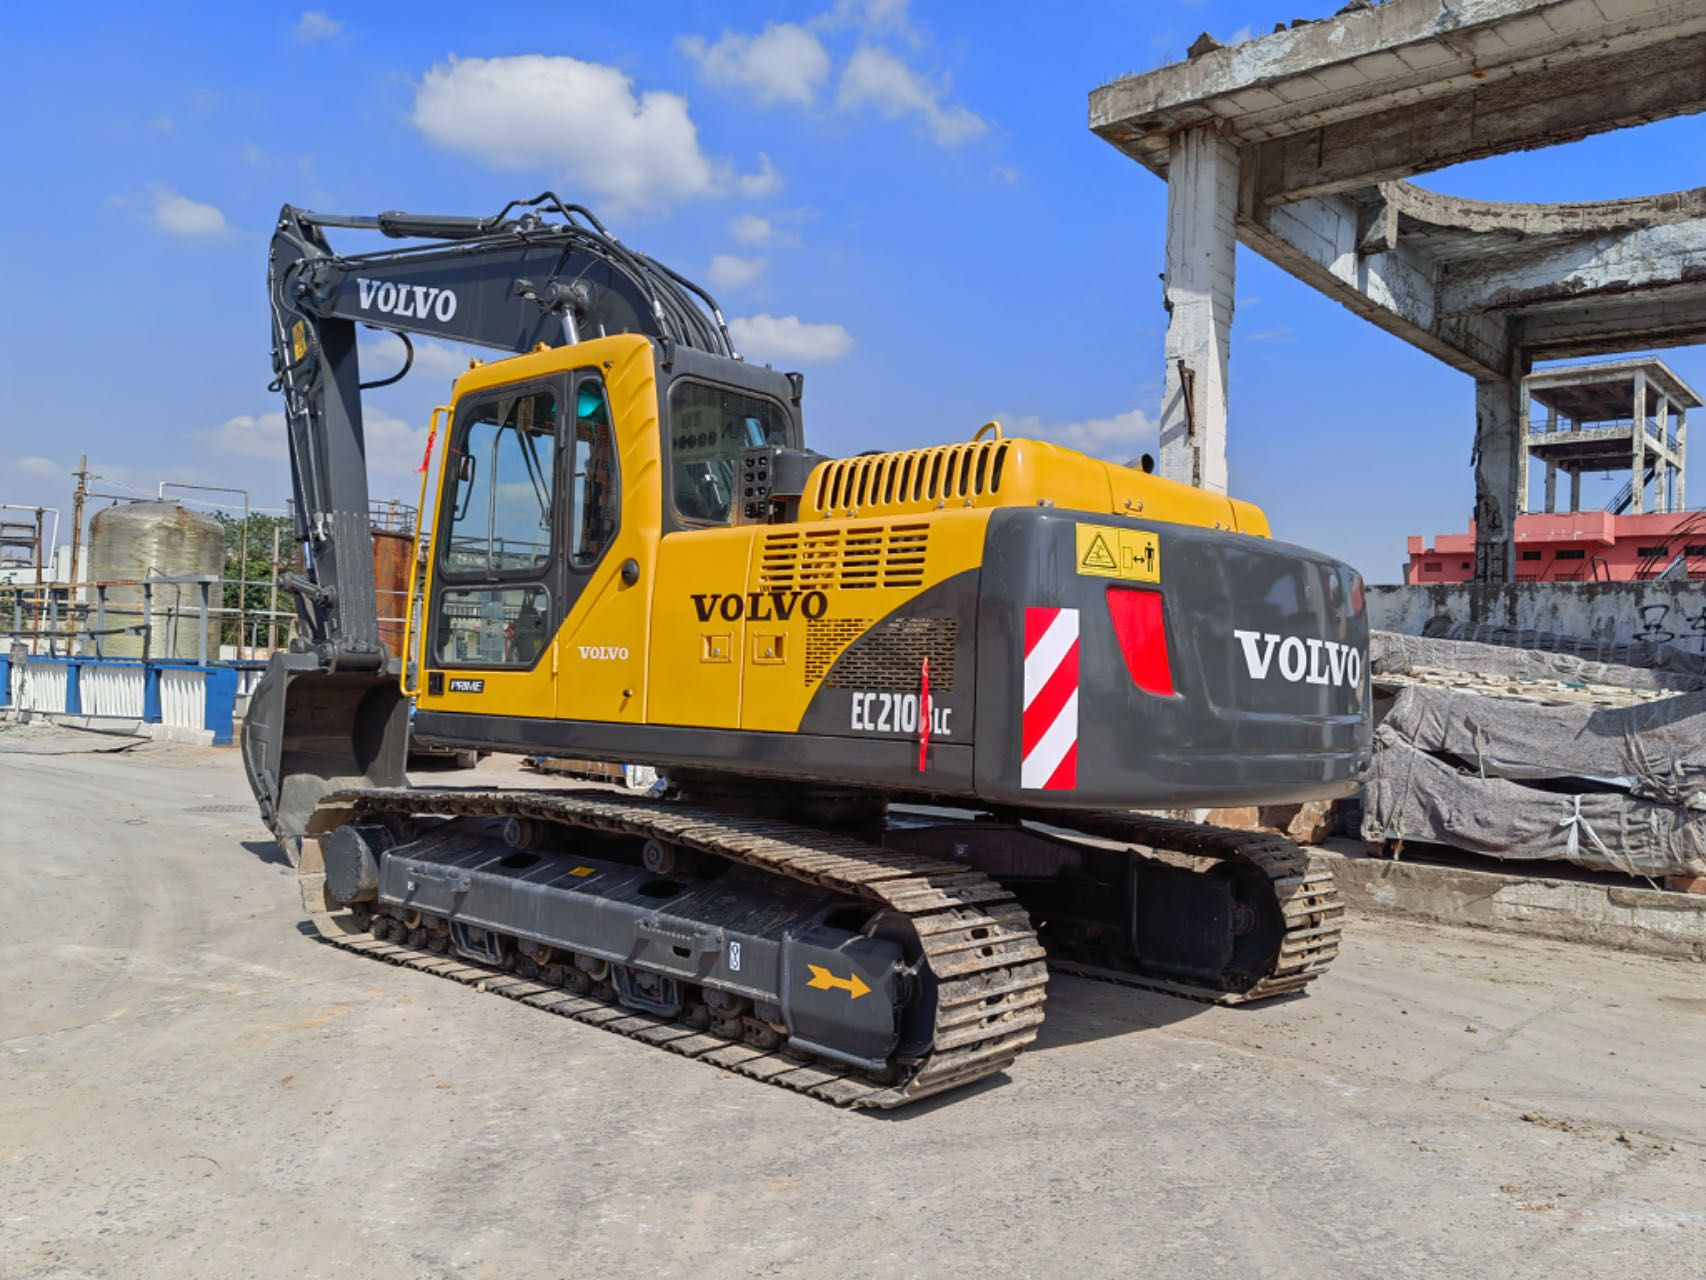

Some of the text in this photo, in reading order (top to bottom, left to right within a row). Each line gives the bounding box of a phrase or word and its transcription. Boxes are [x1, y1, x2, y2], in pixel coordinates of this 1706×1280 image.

[356, 277, 457, 323] VOLVO
[690, 590, 829, 622] VOLVO
[577, 645, 630, 661] VOLVO
[1233, 629, 1361, 689] VOLVO
[450, 680, 484, 692] PRIME
